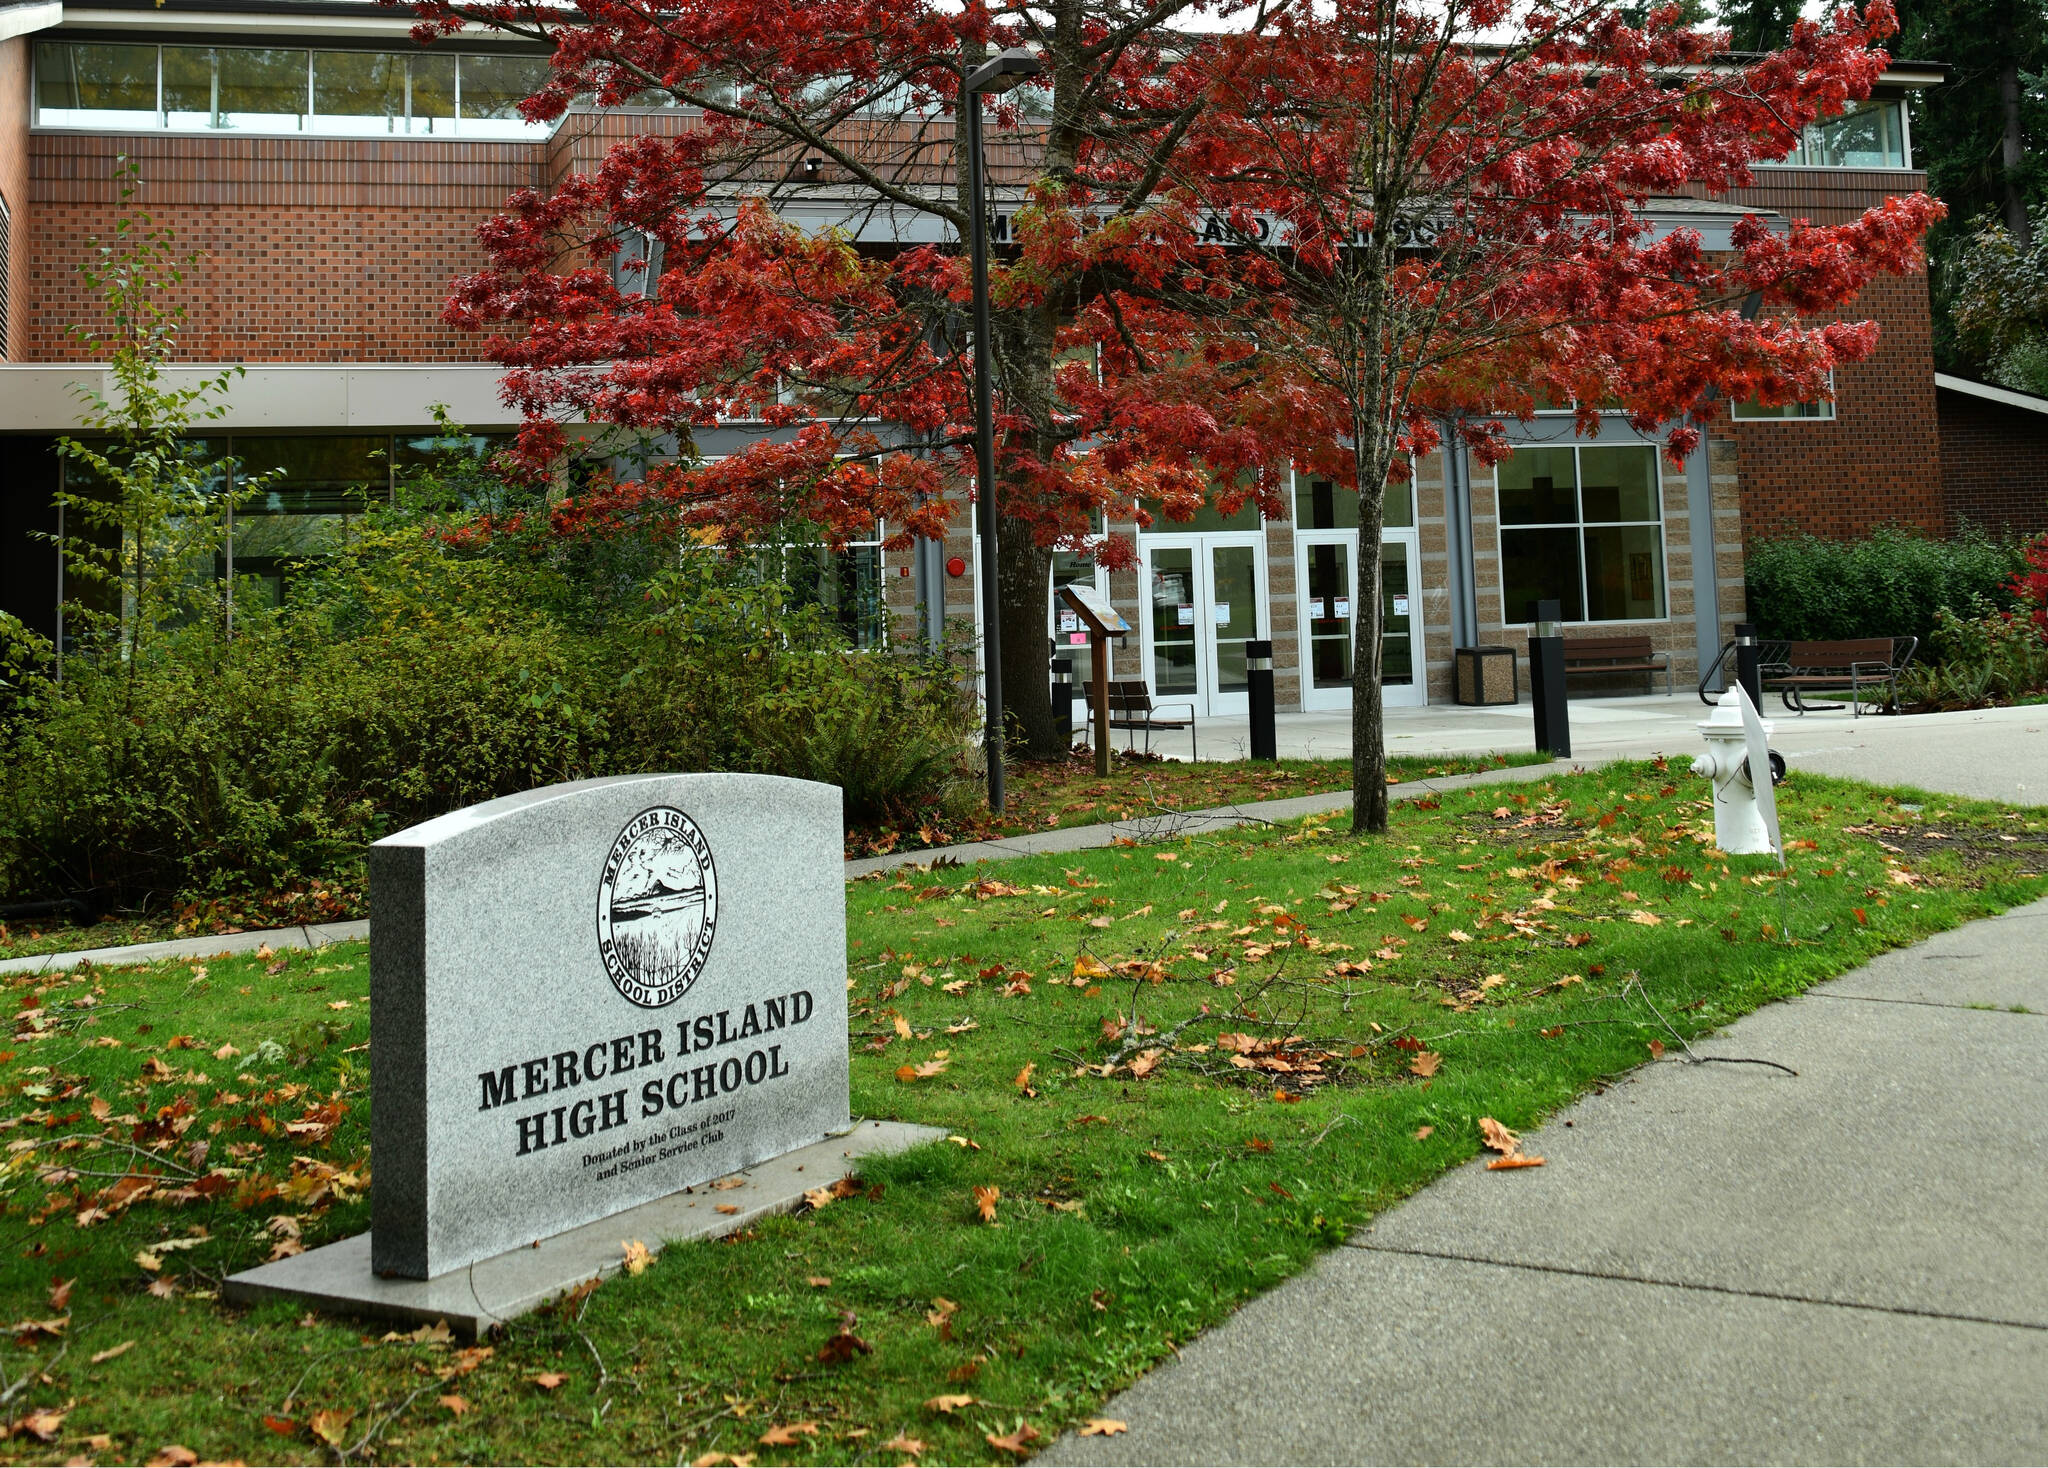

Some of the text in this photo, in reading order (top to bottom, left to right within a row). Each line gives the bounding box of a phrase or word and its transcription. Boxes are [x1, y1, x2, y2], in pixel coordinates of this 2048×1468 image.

[603, 811, 711, 888] MERCER ISLAND
[601, 916, 715, 1005] SCHOOL DISTRICT
[478, 990, 814, 1112] MERCER ISLAND
[515, 1044, 790, 1158] HIGH SCHOOL
[582, 1109, 736, 1168] Donated by the Class of 2017
[596, 1129, 724, 1181] and Senior Service Club
